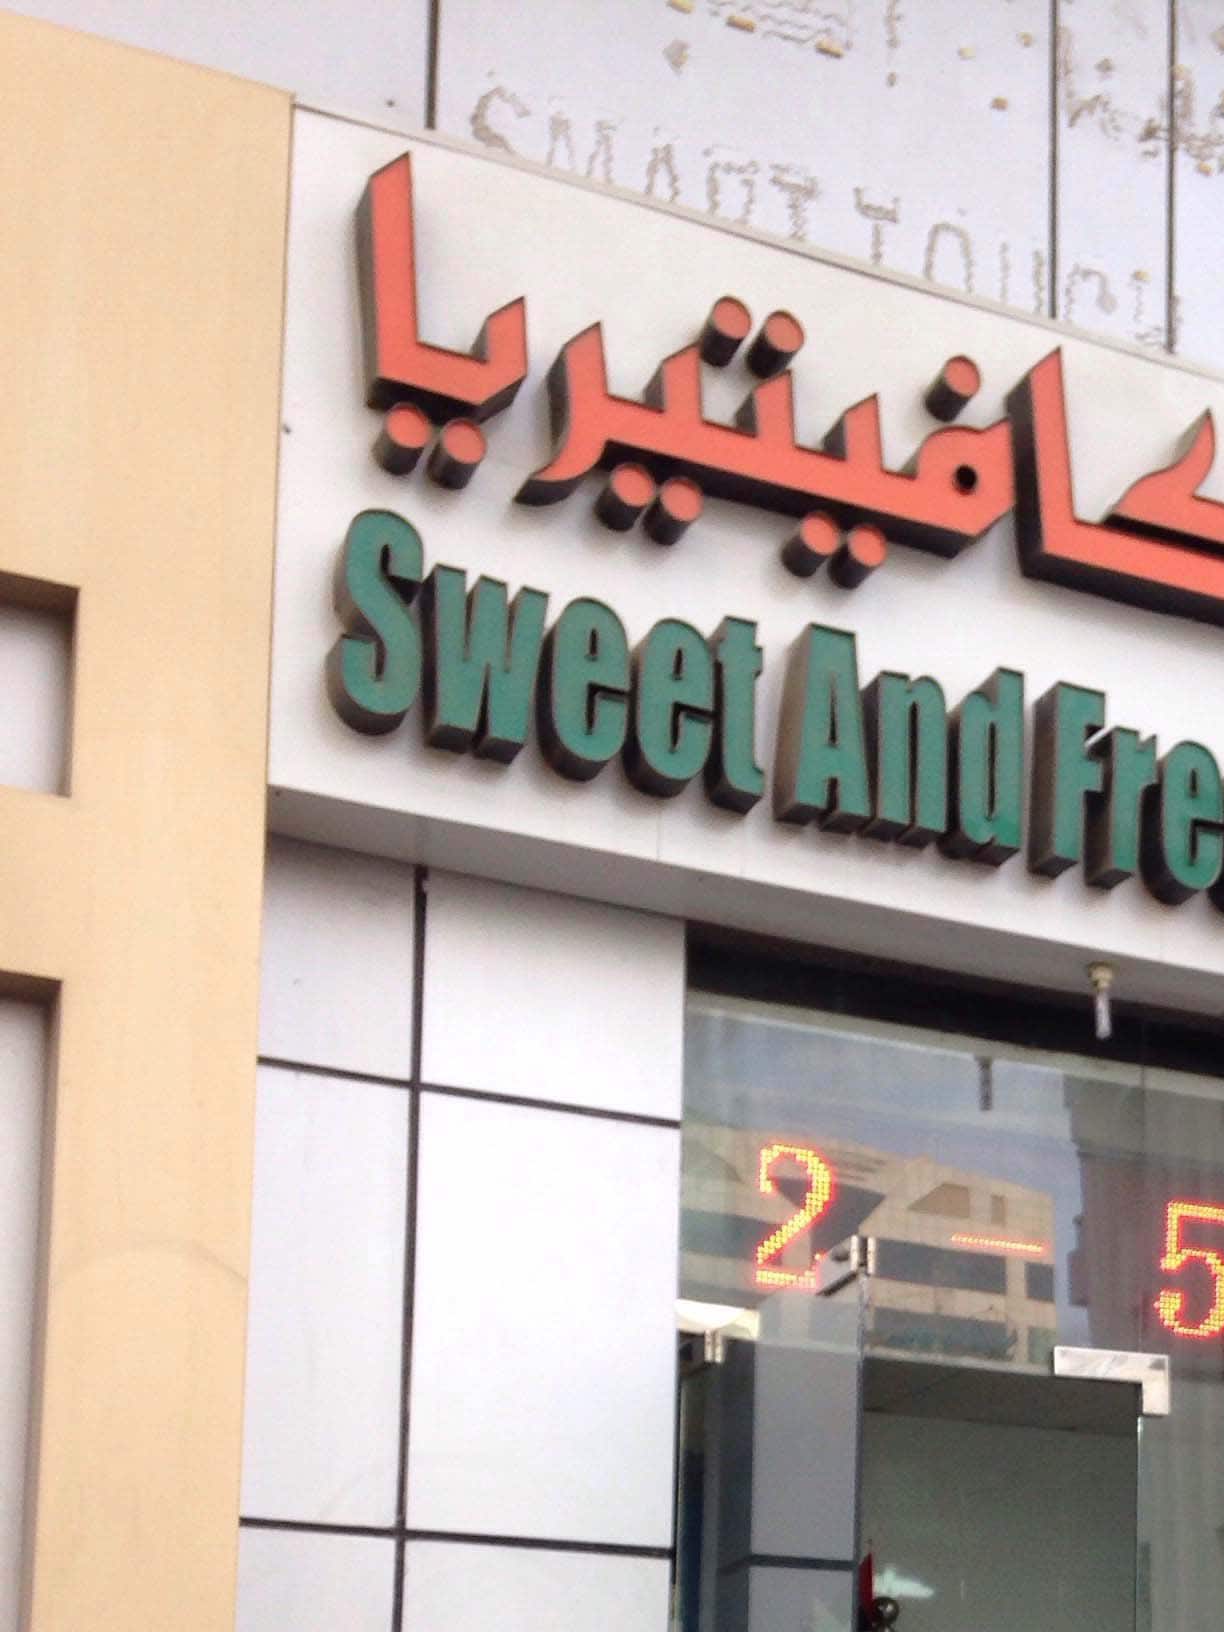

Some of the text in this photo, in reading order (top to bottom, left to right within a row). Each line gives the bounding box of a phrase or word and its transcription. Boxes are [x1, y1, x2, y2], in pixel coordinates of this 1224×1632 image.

[325, 508, 764, 815] Sweet
[775, 622, 1022, 868] And
[754, 1142, 834, 1290] 2
